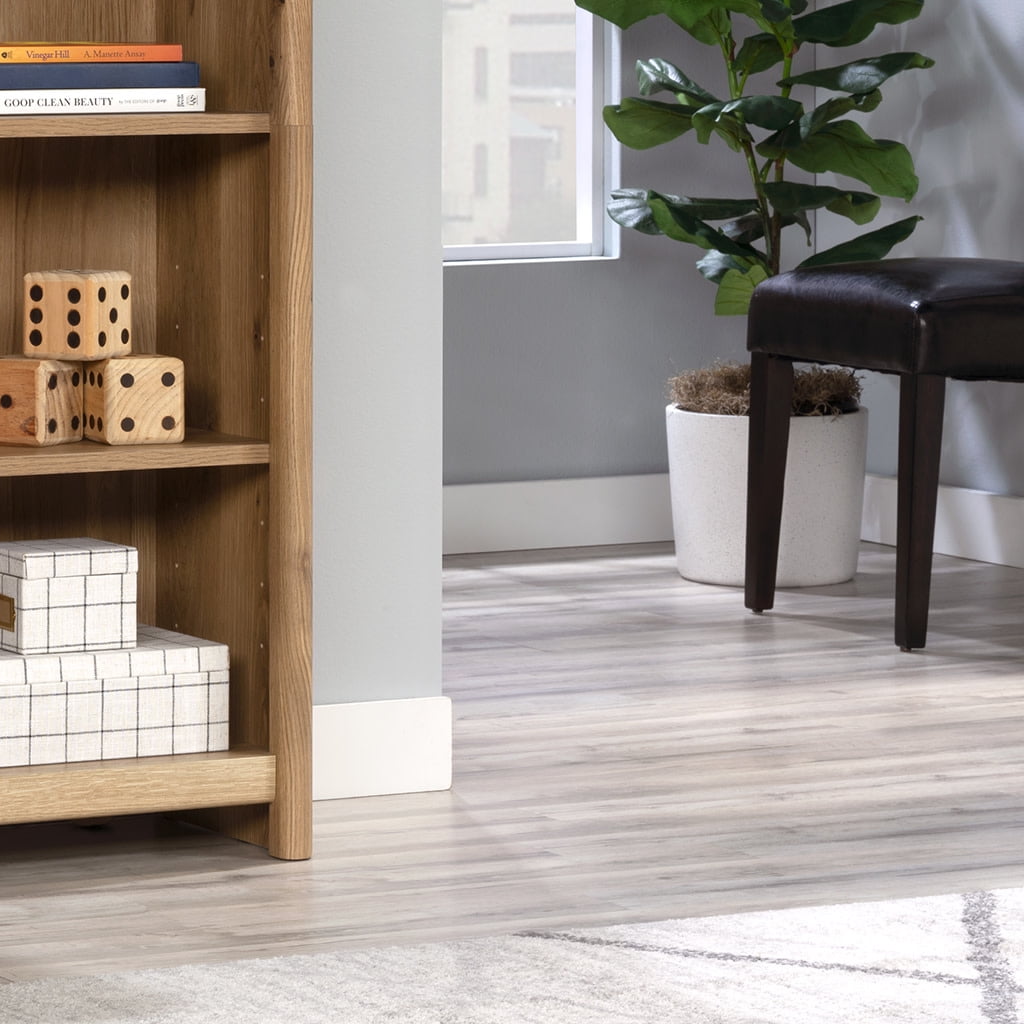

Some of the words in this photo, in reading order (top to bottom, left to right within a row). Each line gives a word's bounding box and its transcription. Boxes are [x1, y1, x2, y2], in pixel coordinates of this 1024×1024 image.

[26, 50, 54, 61] Vinegar
[54, 49, 70, 59] Hill
[83, 50, 92, 58] A.
[93, 49, 124, 58] Manette
[4, 97, 35, 108] GOOP
[36, 97, 71, 107] CLEAN
[74, 96, 113, 107] BEAUTY
